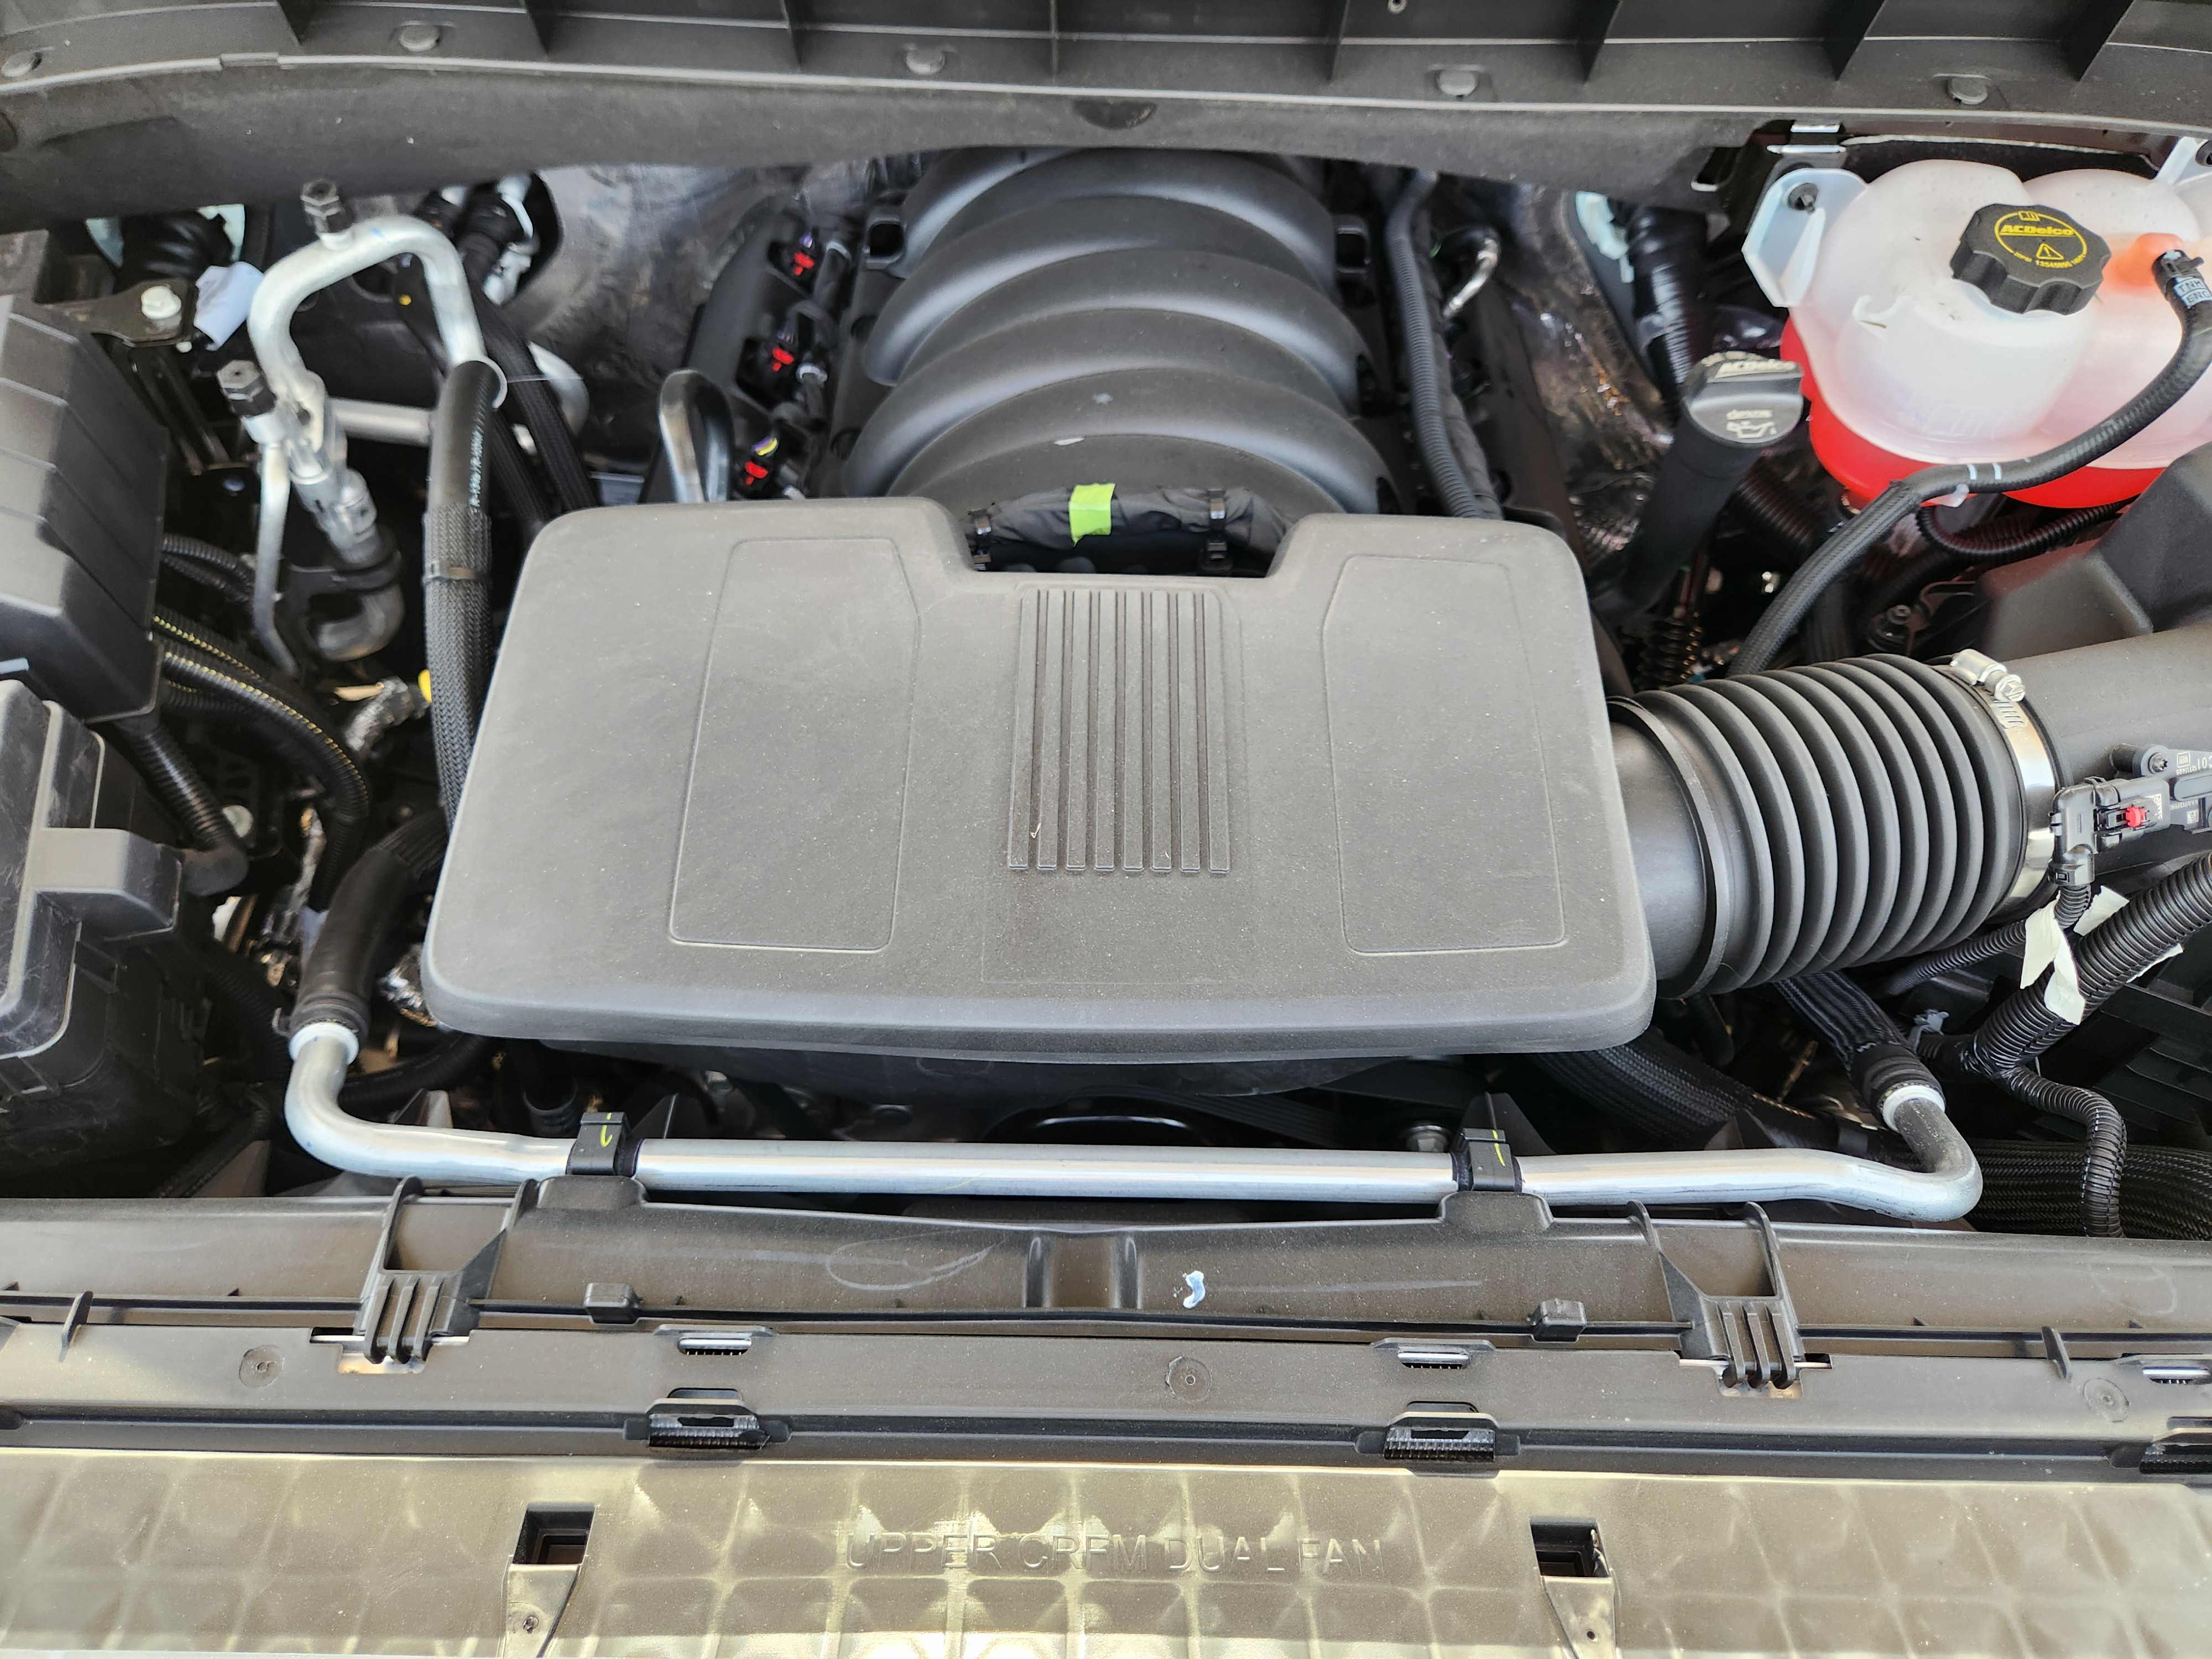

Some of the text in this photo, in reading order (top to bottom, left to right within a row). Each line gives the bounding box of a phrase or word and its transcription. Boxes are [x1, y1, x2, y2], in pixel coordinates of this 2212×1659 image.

[2000, 225, 2074, 236] ACDelco
[2186, 290, 2210, 303] ENG
[846, 1532, 1384, 1576] UPPER CRFM DUAL FAN
